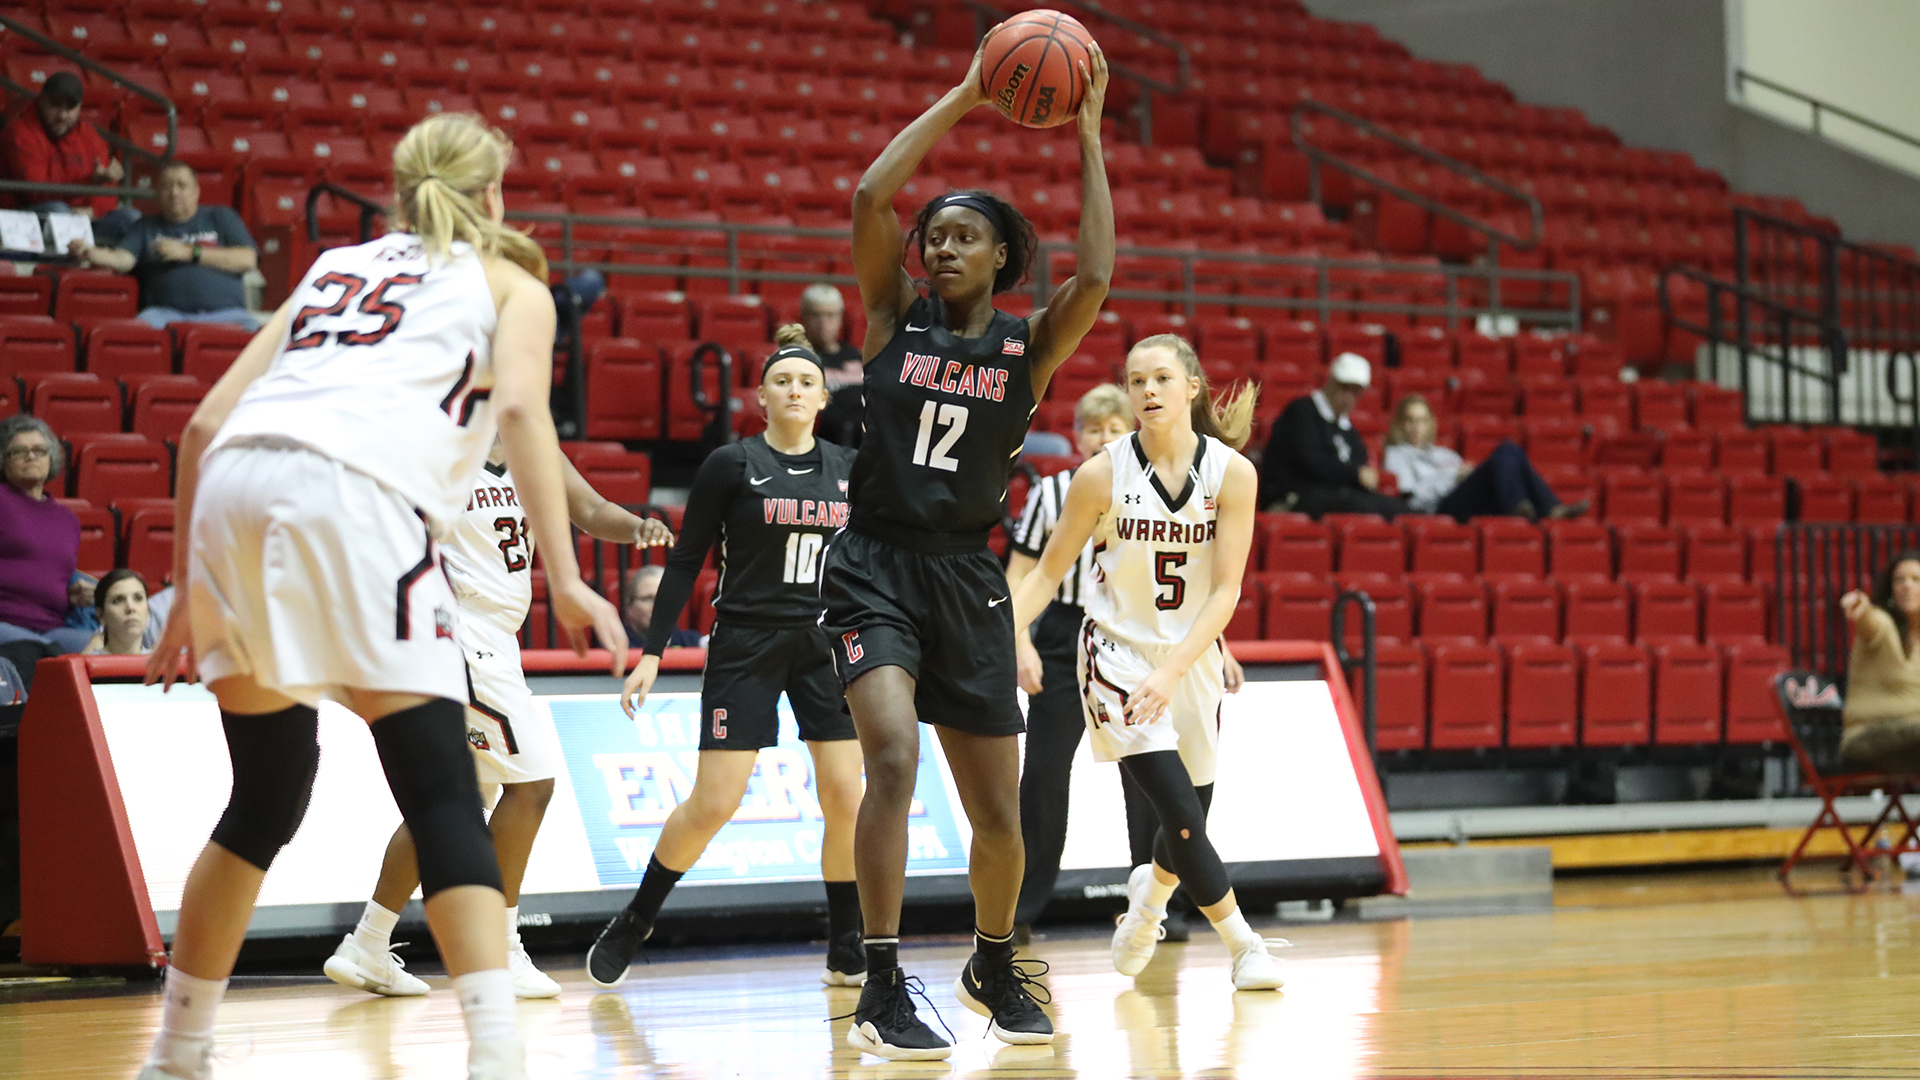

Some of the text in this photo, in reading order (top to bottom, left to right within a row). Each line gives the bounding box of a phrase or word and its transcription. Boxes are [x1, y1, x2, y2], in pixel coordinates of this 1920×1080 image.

[1030, 85, 1056, 124] NCAA
[285, 270, 427, 352] 25
[899, 351, 1009, 402] VULCANS
[912, 399, 969, 472] 12
[763, 498, 850, 528] VULCANS
[783, 532, 823, 583] 10
[1155, 551, 1187, 611] 5
[842, 630, 864, 664] C
[713, 708, 727, 739] C
